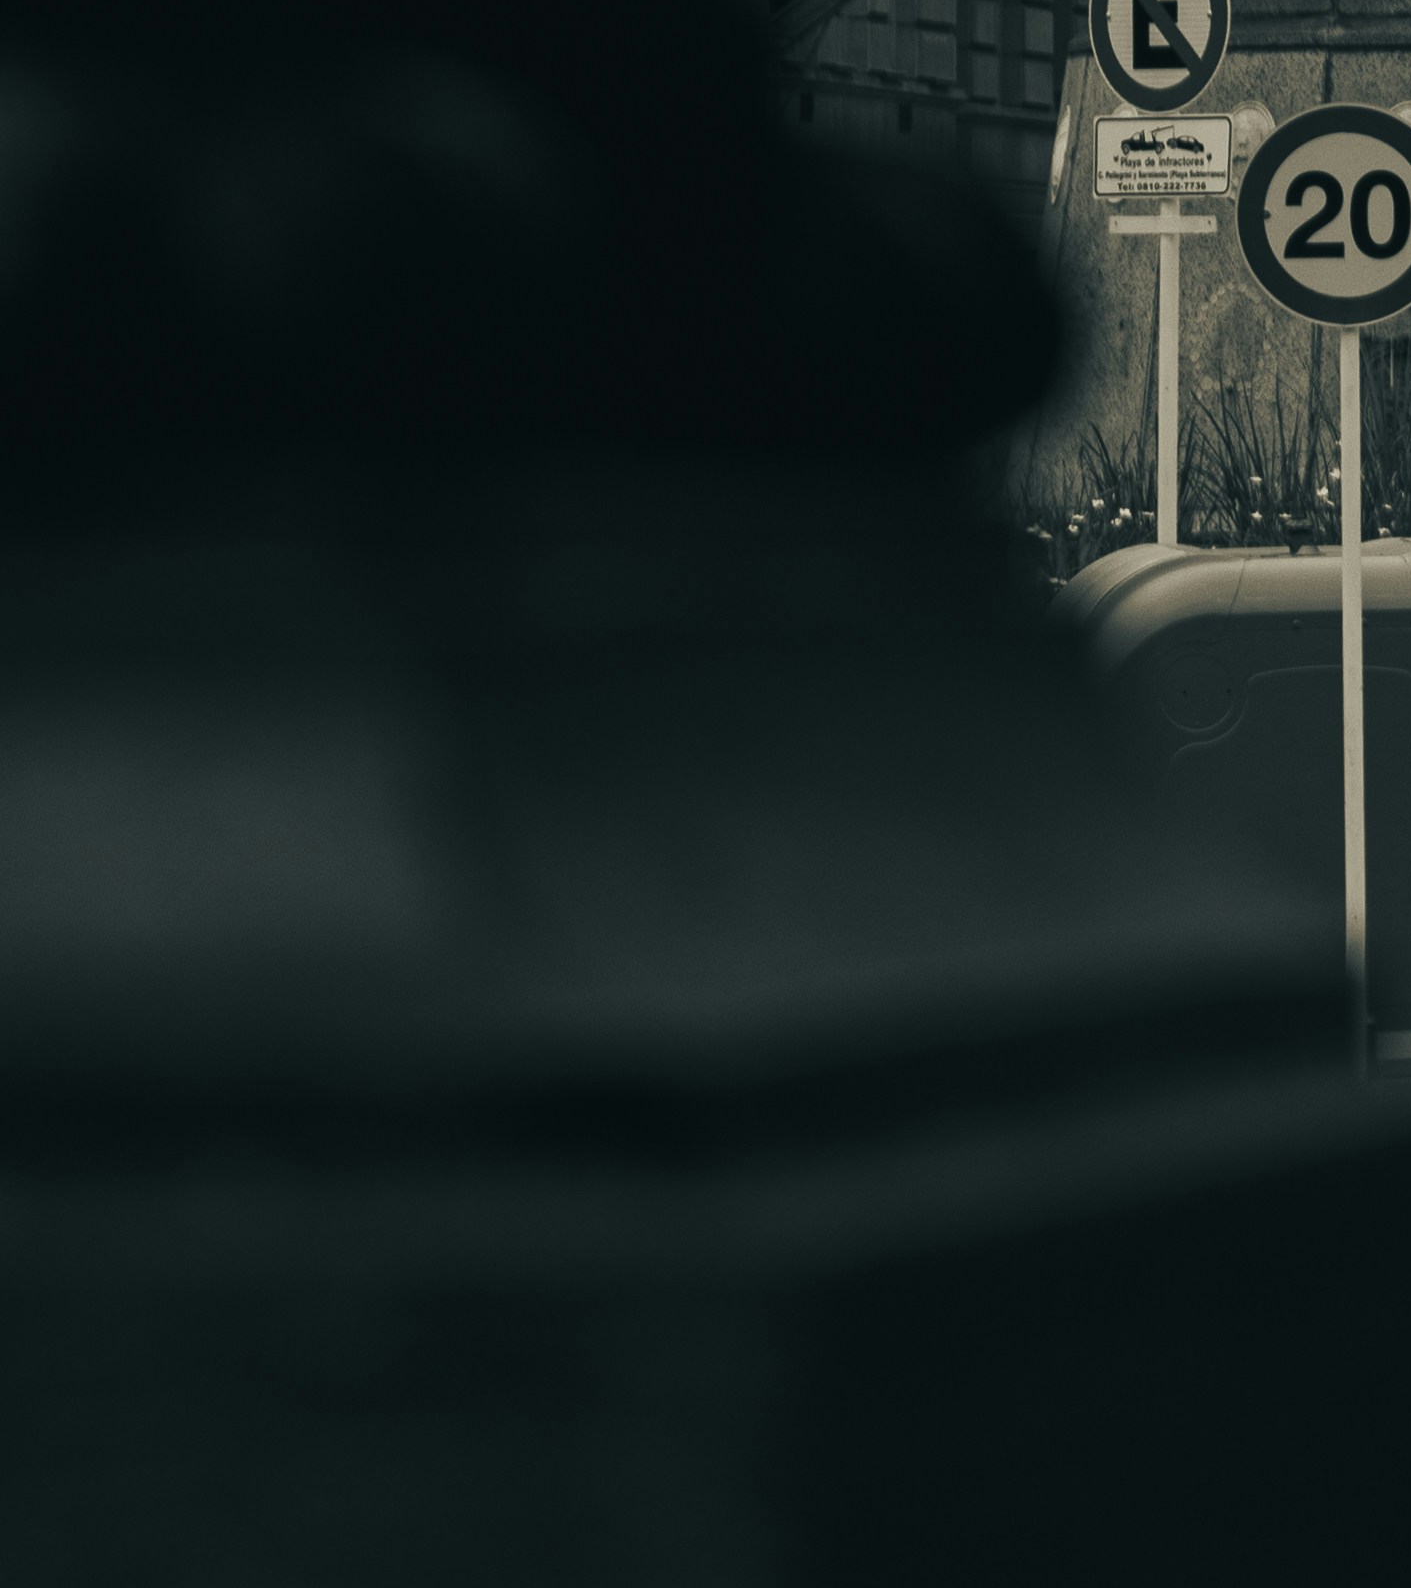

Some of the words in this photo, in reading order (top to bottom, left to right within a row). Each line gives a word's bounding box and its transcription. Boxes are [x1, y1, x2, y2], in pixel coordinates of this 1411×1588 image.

[1120, 157, 1141, 168] Playa
[1145, 157, 1155, 166] de
[1159, 157, 1204, 167] infractores
[1117, 182, 1134, 190] Tel:
[1283, 169, 1411, 260] 20
